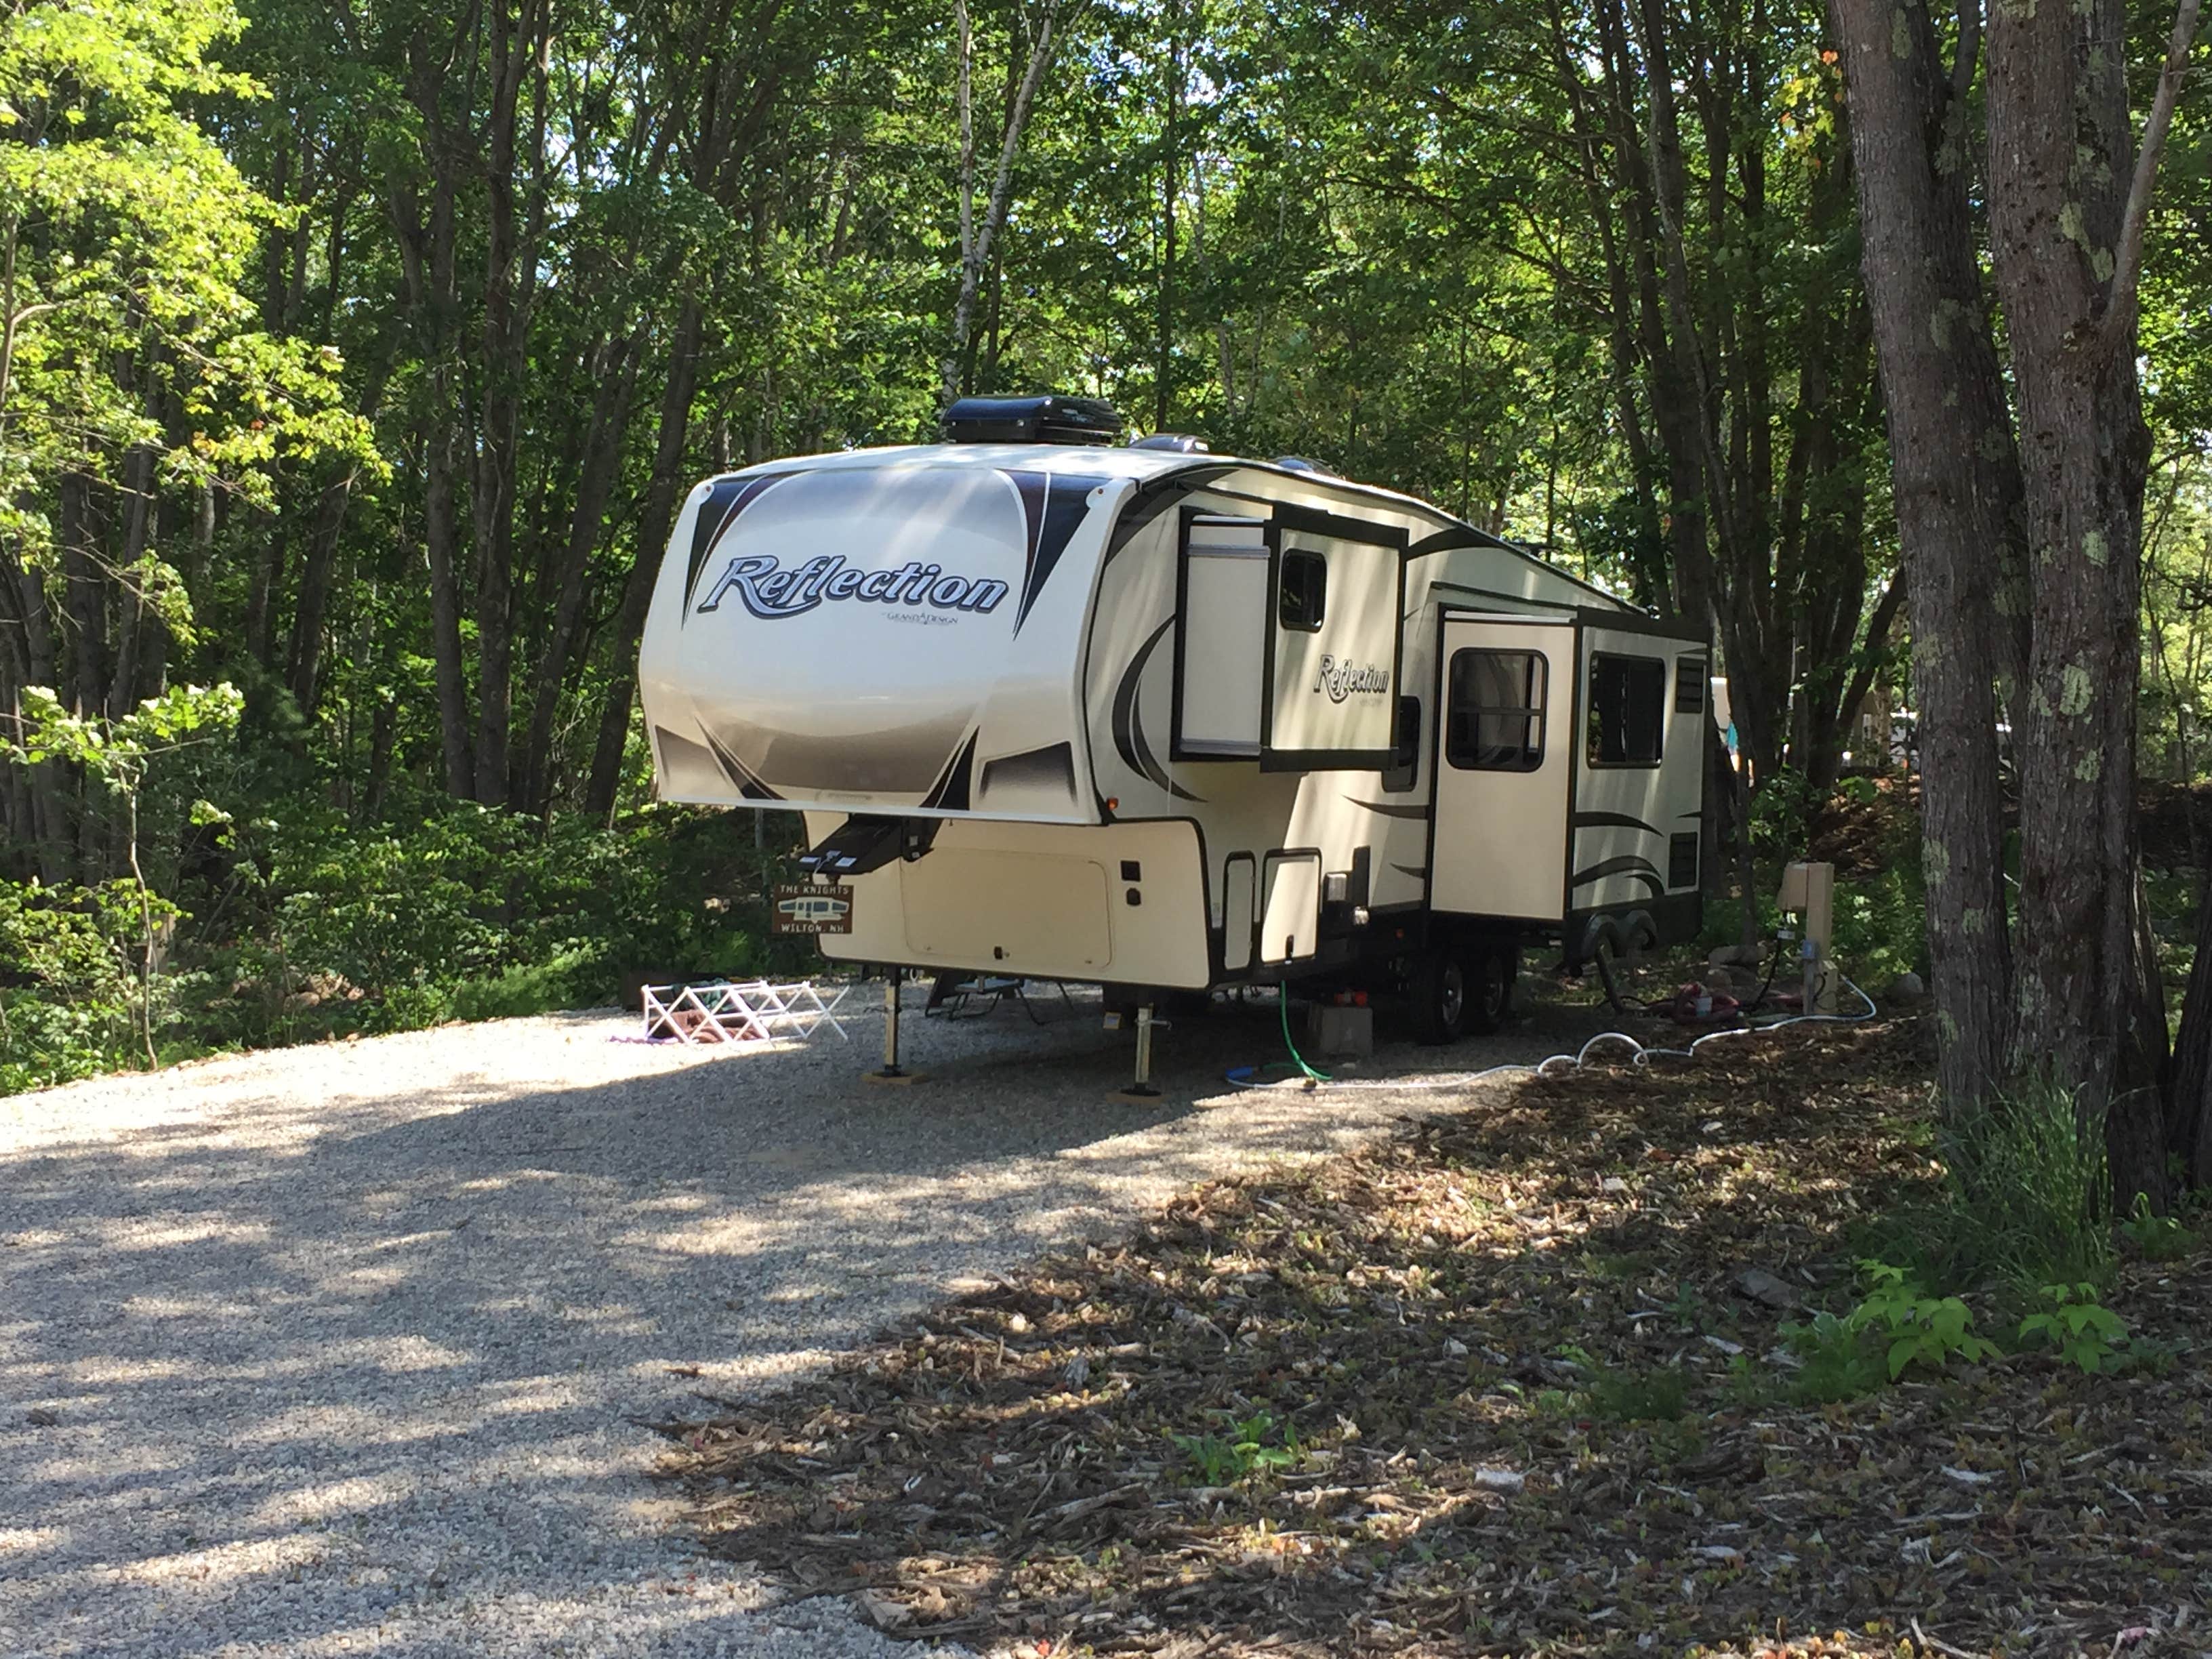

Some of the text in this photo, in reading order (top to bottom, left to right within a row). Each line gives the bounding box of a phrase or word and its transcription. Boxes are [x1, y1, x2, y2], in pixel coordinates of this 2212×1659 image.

[697, 555, 1008, 619] Reflection
[1313, 654, 1389, 703] Reflection
[780, 884, 848, 895] THE KNIGHTS
[830, 924, 844, 933] NH
